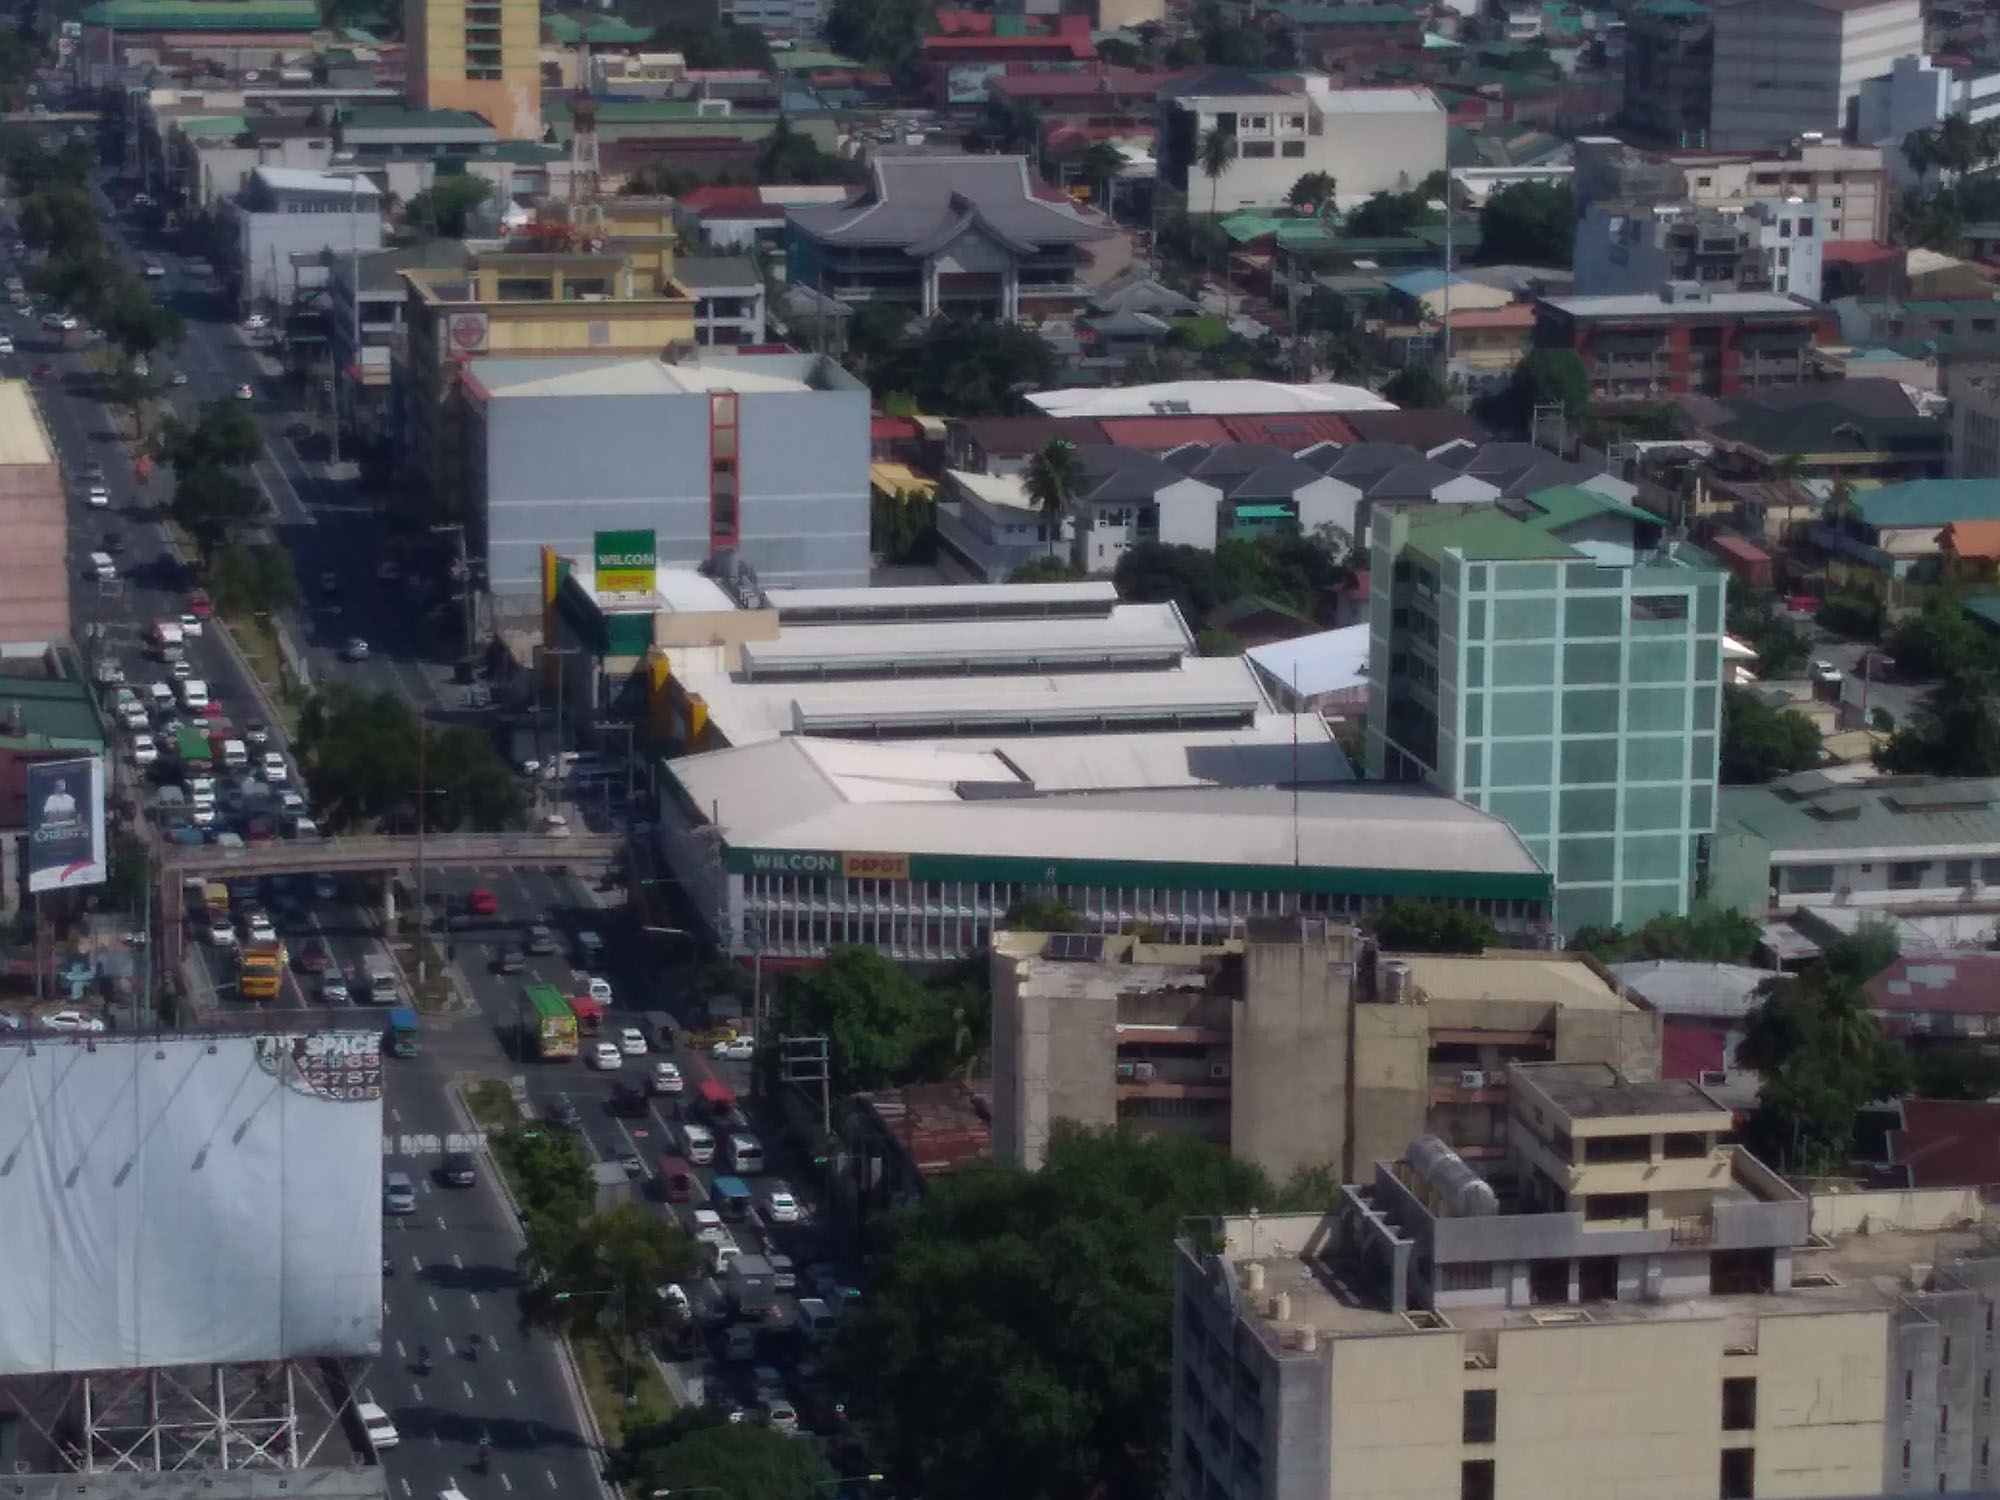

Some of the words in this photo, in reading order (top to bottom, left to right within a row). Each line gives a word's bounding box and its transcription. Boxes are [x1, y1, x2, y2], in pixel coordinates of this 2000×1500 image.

[599, 553, 655, 566] WILCON
[752, 854, 836, 872] WILCON
[849, 857, 905, 873] DEPOT
[305, 1033, 380, 1056] SPACE
